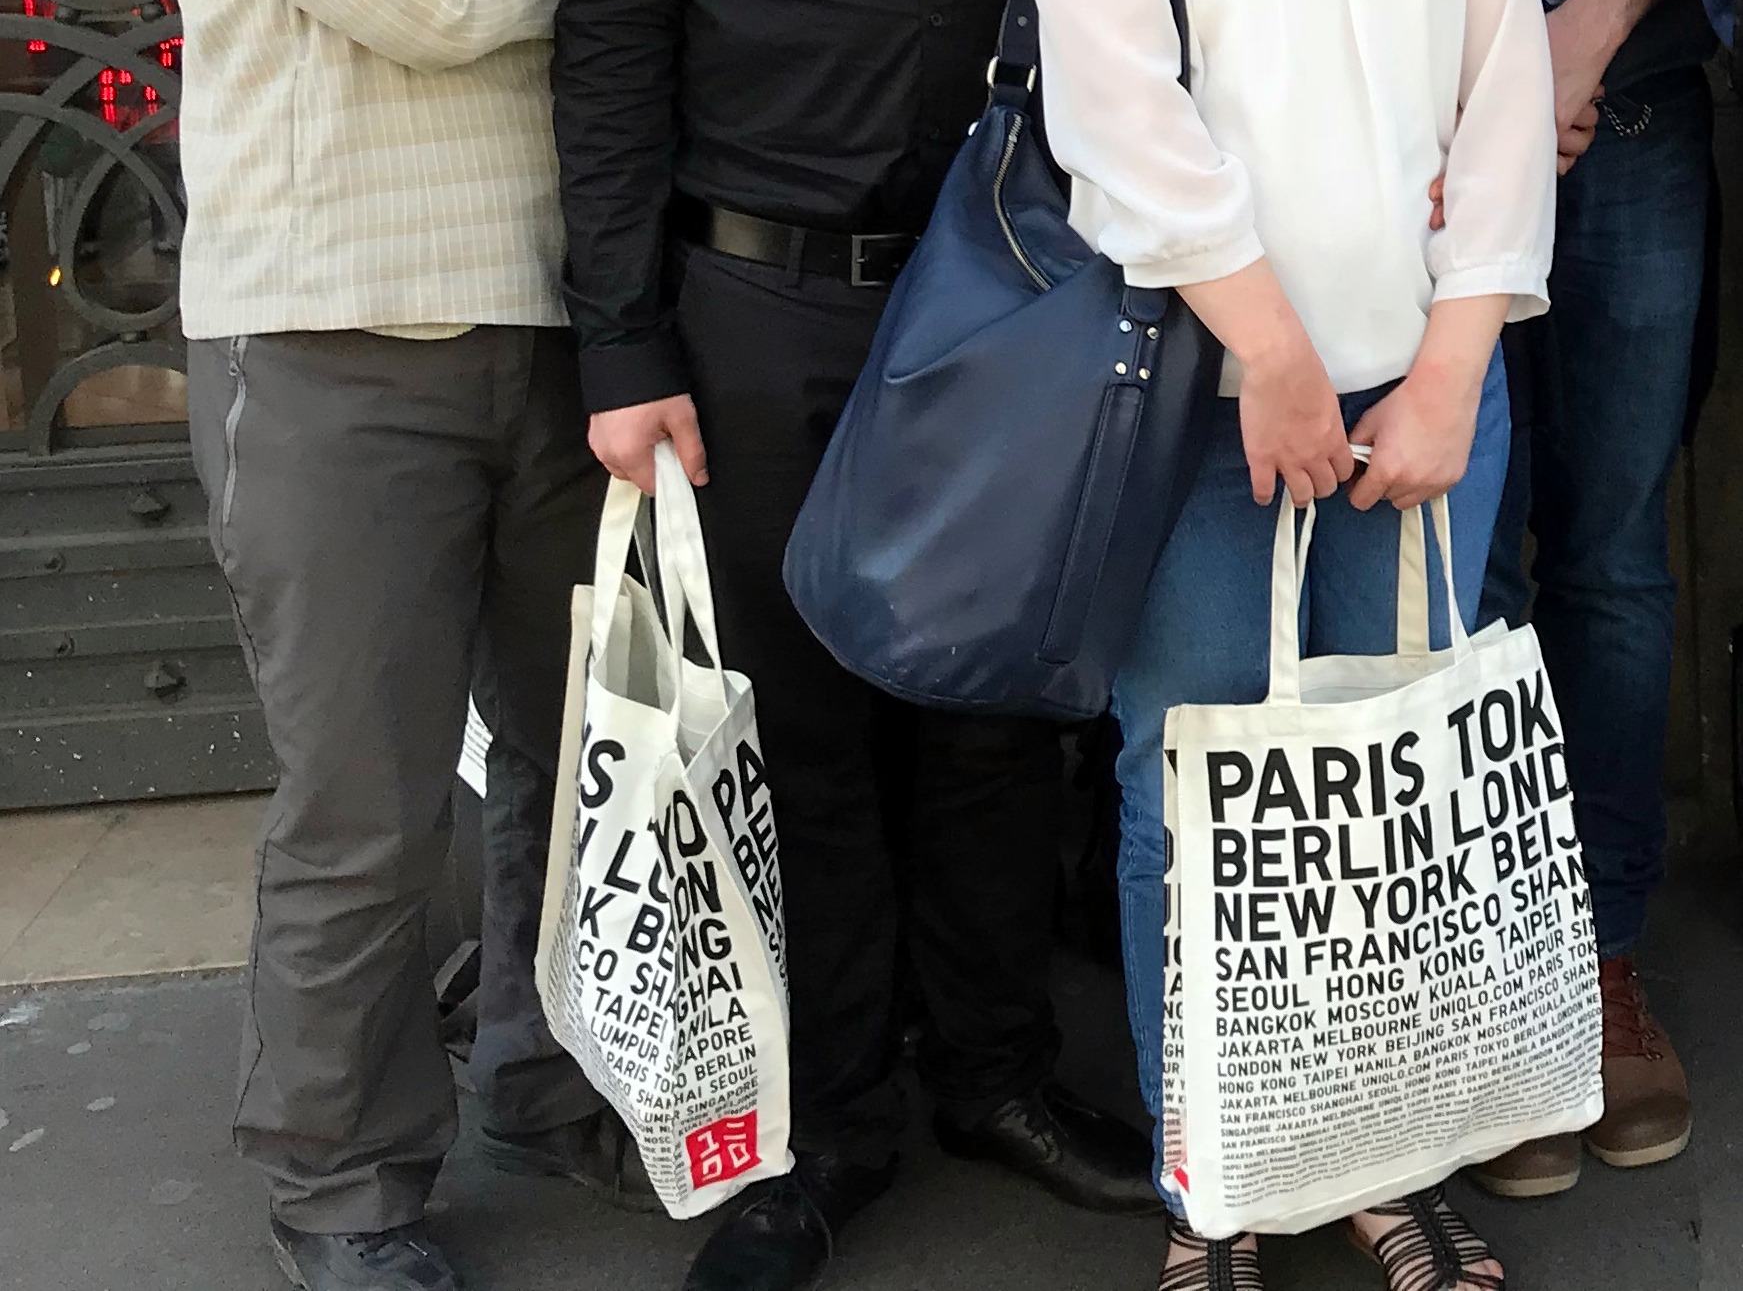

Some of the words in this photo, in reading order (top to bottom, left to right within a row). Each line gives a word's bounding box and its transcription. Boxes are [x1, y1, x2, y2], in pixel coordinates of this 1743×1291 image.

[1206, 730, 1425, 824] PARIS
[1447, 668, 1558, 779] TOK
[1213, 803, 1434, 887] BERLIN
[1450, 743, 1570, 847] LOND
[1214, 885, 1336, 943] NEW
[1352, 847, 1477, 929] YORK
[1215, 946, 1288, 981] SAN
[1304, 893, 1501, 976] FRANCISCO
[1215, 984, 1310, 1012] SEOUL
[1326, 967, 1405, 1002] HONG
[1420, 938, 1485, 984] KONG
[1496, 898, 1561, 953] TAIPEI
[1216, 1010, 1317, 1037] BANGKOK
[1328, 990, 1420, 1026] MOSCOW
[1429, 964, 1496, 1003] KUALA
[1503, 928, 1564, 976] LUMPUR
[590, 1016, 660, 1066] LUMPUR
[595, 986, 668, 1043] TAIPEI
[678, 996, 748, 1048] ANILA
[1218, 1036, 1304, 1058] JAKARTA
[1313, 1013, 1422, 1048] MELBOURNE
[1430, 975, 1523, 1022] UNIQLO.COM
[1529, 953, 1564, 985] PARIS
[1218, 1059, 1282, 1078] LONDON
[1290, 1051, 1328, 1071] NEW
[1337, 1042, 1377, 1062] YORK
[1386, 1024, 1444, 1053] BEIJING
[1451, 1011, 1482, 1032] SAN
[1489, 977, 1559, 1023] FRANCISCO
[1563, 960, 1596, 985] SHAN
[1218, 1081, 1254, 1094] HONG
[1261, 1076, 1296, 1091] KONG
[1303, 1066, 1348, 1086] TAIPEI
[1354, 1054, 1407, 1076] MANILA
[1413, 1033, 1471, 1060] BANGKOK
[1477, 1012, 1528, 1041] MOSCOW
[1532, 993, 1566, 1021] KUALA
[607, 1051, 649, 1083] PARIS
[687, 1076, 758, 1115] SINGAPORE
[695, 1043, 757, 1081] BERLIN
[710, 1066, 758, 1094] SEOUL
[1220, 1095, 1278, 1110] JAKARTA
[1283, 1080, 1357, 1104] MELBOURNE
[1362, 1063, 1431, 1088] UNIQLO.COM
[1435, 1050, 1469, 1068] PARIS
[1474, 1038, 1509, 1056] TOKYO
[1513, 1020, 1547, 1044] BERLIN
[1551, 1000, 1583, 1026] LONDON
[1220, 1113, 1241, 1124] SAN
[1245, 1106, 1306, 1123] FRANCISCO
[1310, 1094, 1363, 1114] SHANGHAI
[1368, 1084, 1400, 1100] SEOUL
[1435, 1066, 1461, 1080] KONG
[1466, 1054, 1498, 1072] TAIPEI
